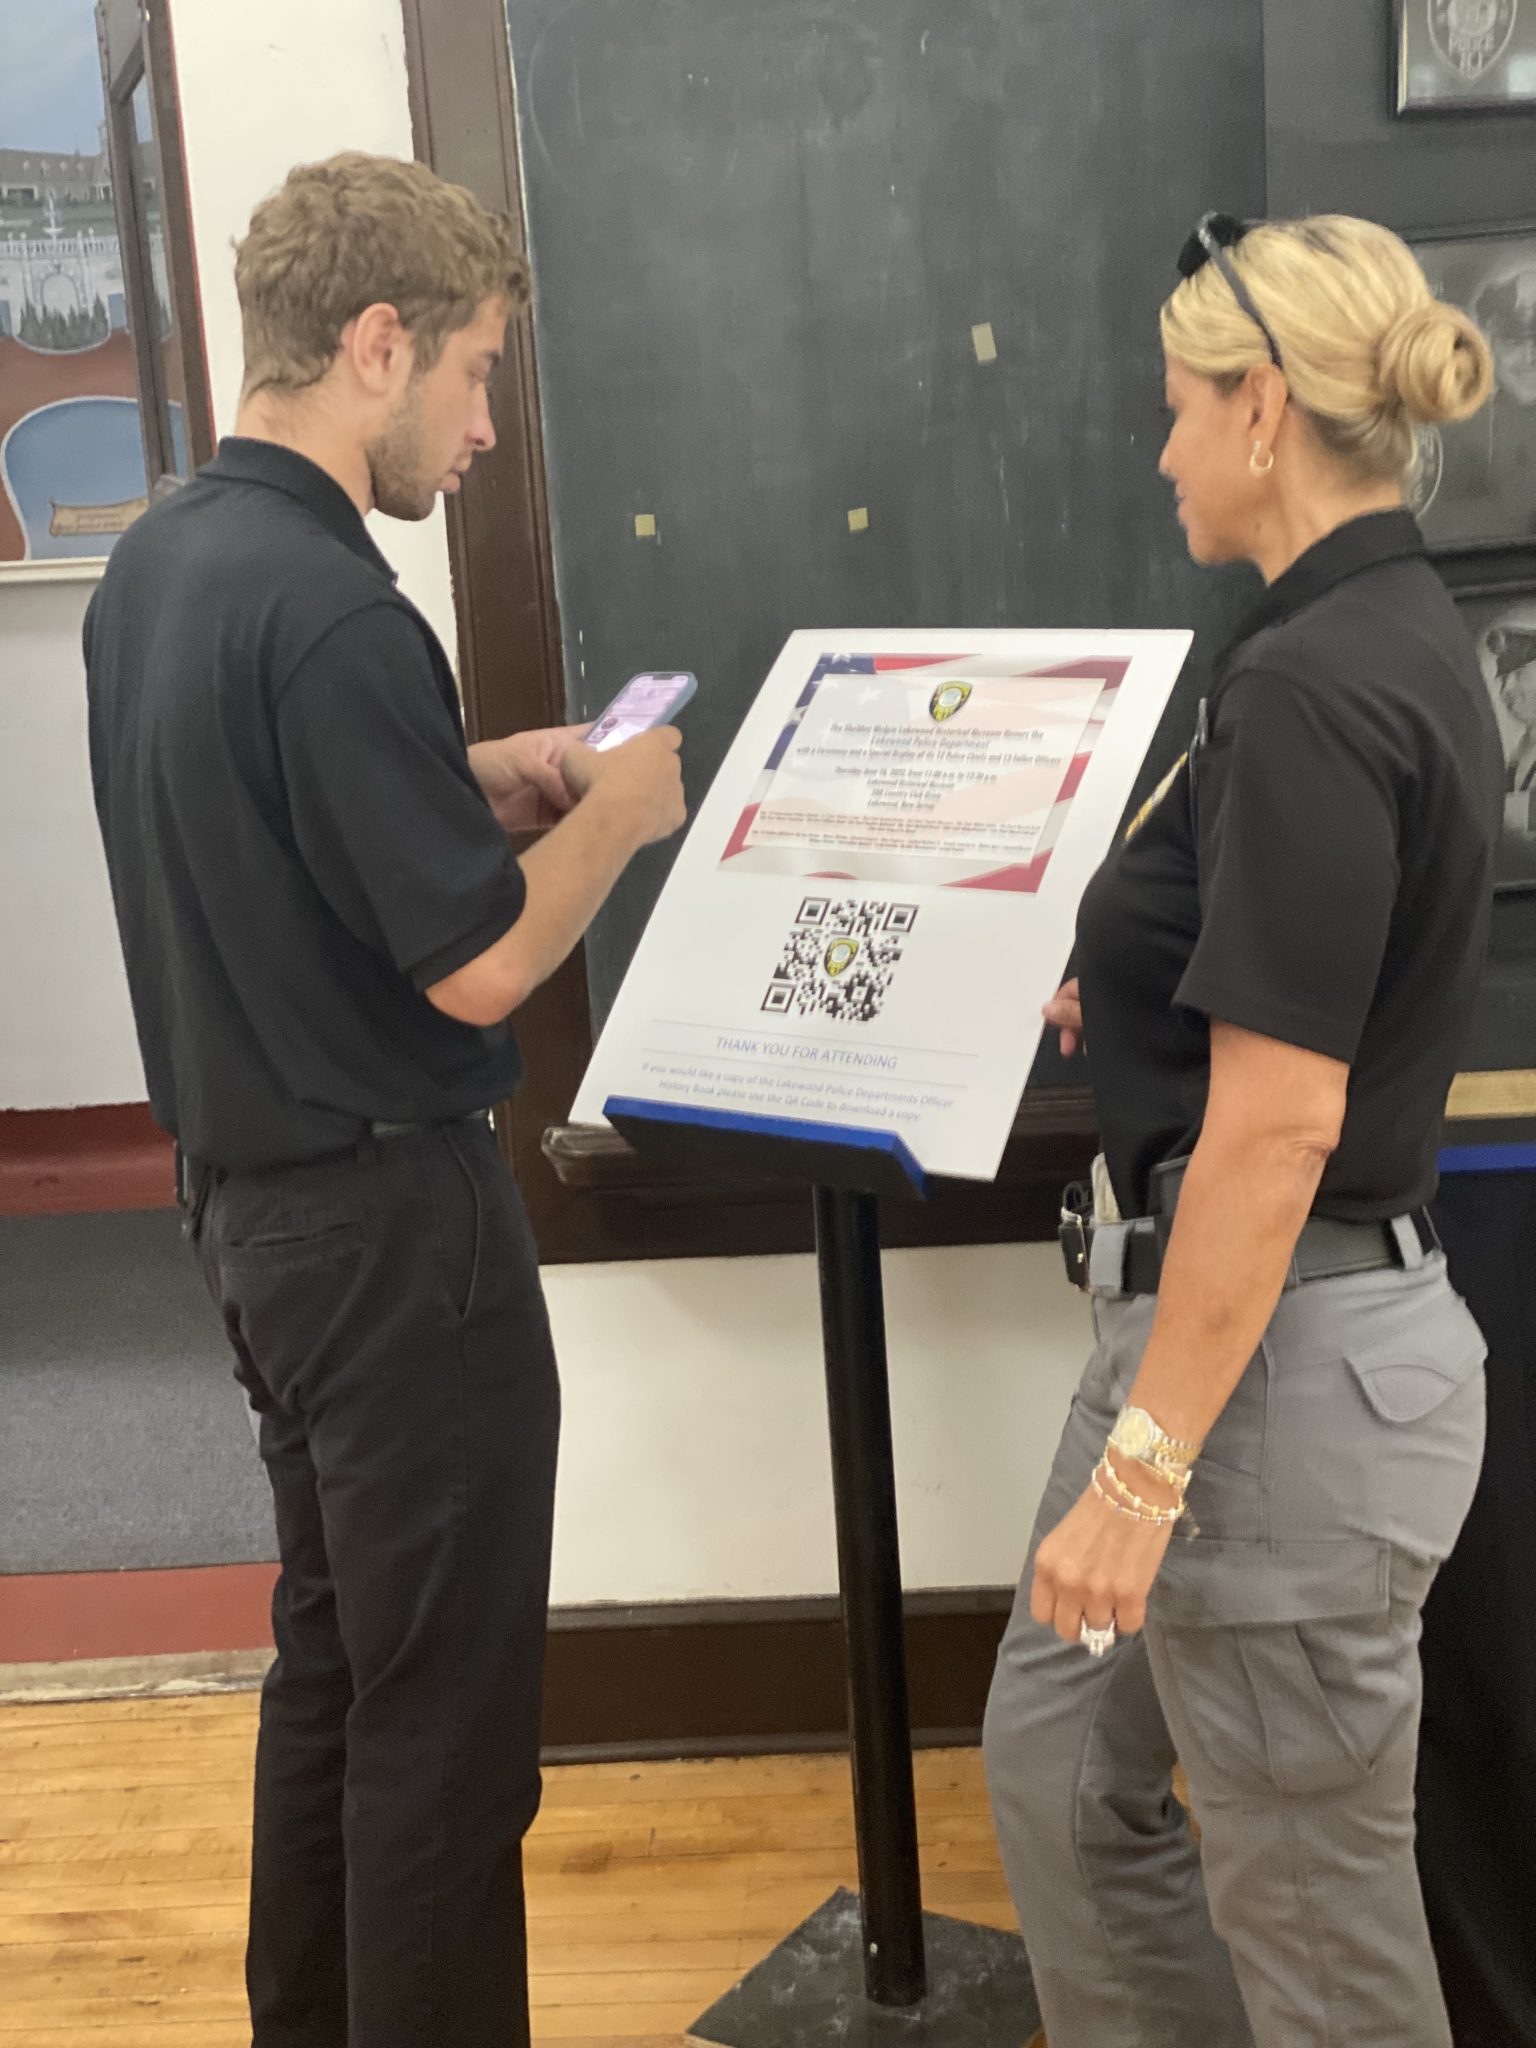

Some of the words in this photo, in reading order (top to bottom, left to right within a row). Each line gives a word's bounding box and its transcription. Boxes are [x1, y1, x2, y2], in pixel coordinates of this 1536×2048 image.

[830, 723, 843, 733] The
[898, 726, 935, 735] Lakewood
[1031, 730, 1044, 739] the
[870, 735, 913, 746] Lakewood
[913, 737, 938, 747] Police
[938, 738, 990, 749] Department
[866, 777, 899, 787] Lakewood
[716, 1036, 760, 1053] THANK
[762, 1041, 790, 1057] YOU
[791, 1045, 818, 1061] FOR
[819, 1048, 899, 1069] ATTENDING
[650, 1064, 667, 1075] you
[669, 1065, 698, 1077] would
[698, 1067, 715, 1080] like
[723, 1072, 745, 1085] copy
[746, 1073, 759, 1084] of
[759, 1075, 775, 1087] the
[776, 1077, 825, 1093] Lakewood
[825, 1082, 855, 1098] Police
[855, 1087, 918, 1106] Departments
[919, 1094, 955, 1110] Officer
[658, 1079, 691, 1094] History
[692, 1083, 715, 1096] Book
[716, 1086, 748, 1099] please
[748, 1090, 766, 1102] use
[766, 1091, 783, 1103] the
[784, 1094, 800, 1107] QR
[800, 1096, 825, 1110] Code
[826, 1099, 838, 1111] to
[838, 1102, 888, 1118] download
